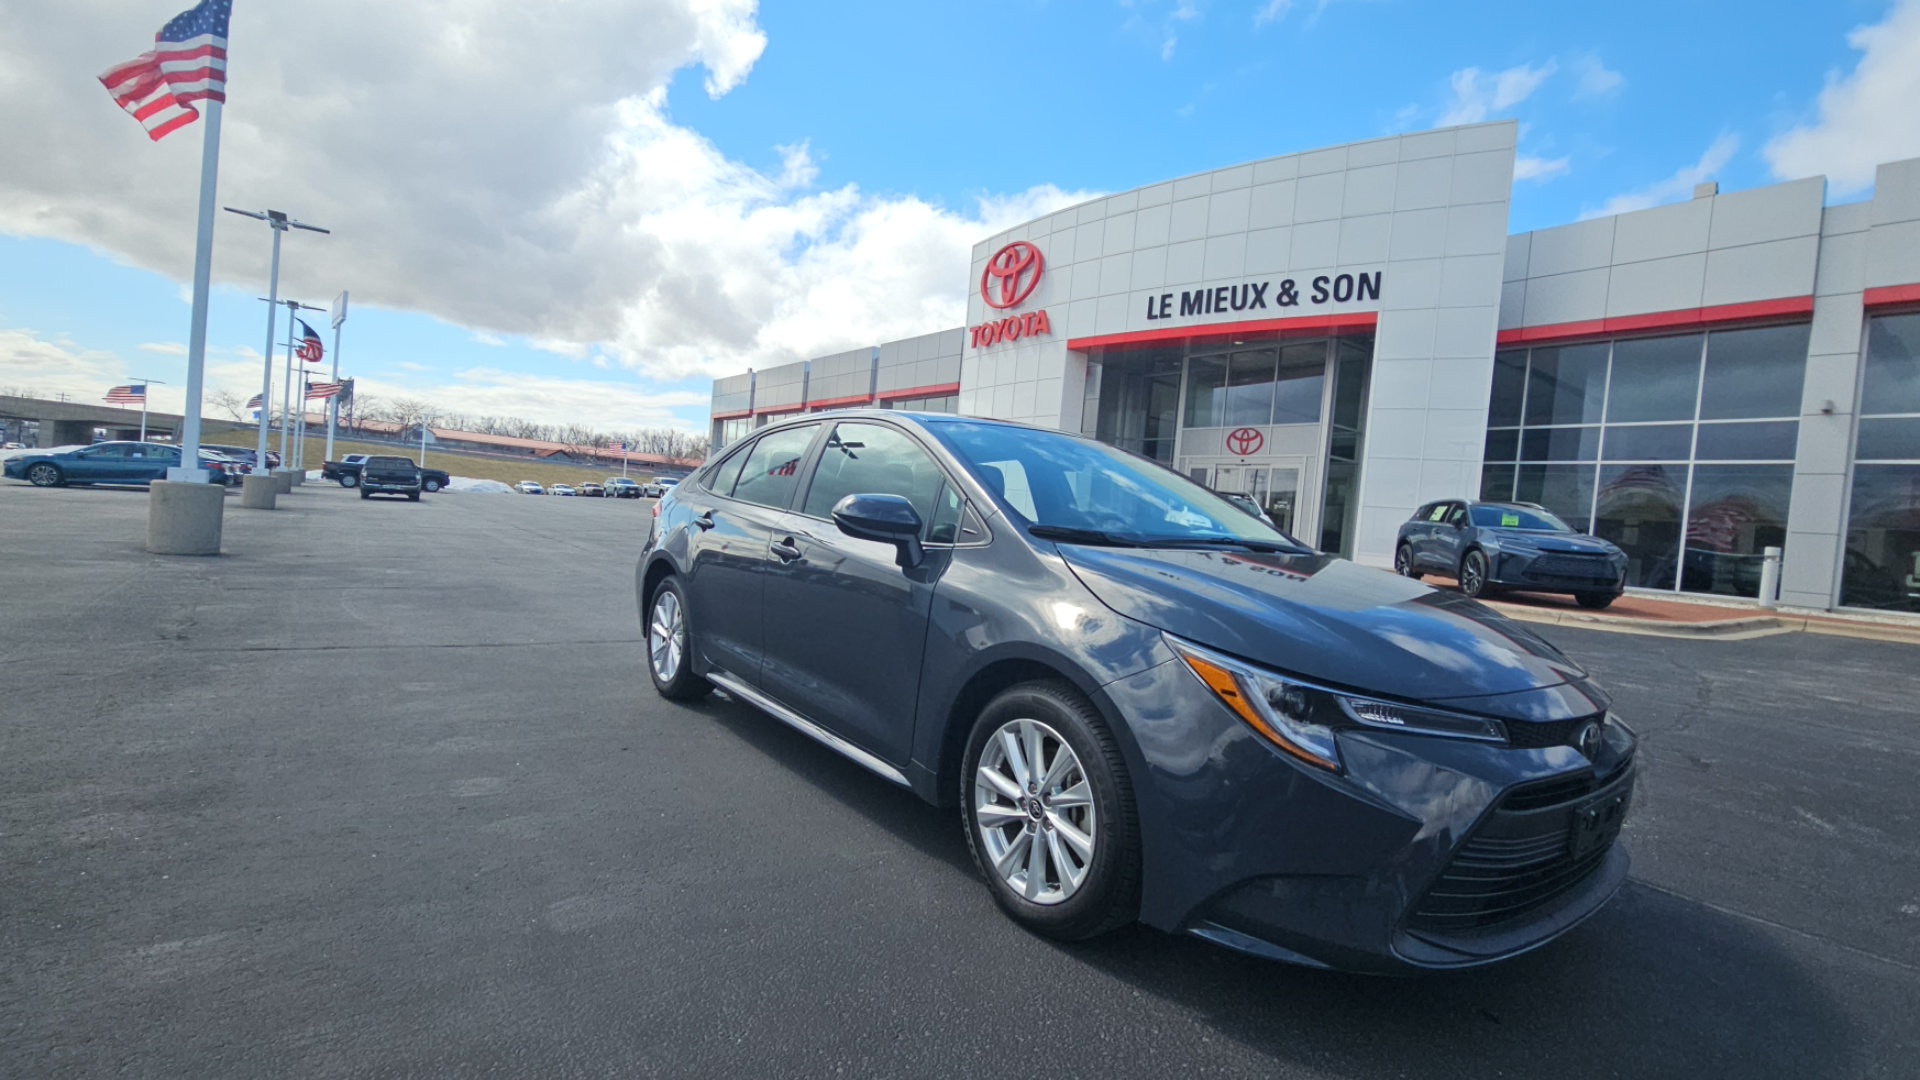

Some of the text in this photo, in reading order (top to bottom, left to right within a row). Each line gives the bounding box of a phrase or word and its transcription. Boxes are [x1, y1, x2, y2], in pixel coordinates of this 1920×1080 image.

[1146, 271, 1382, 320] LE MIEUX & SON
[969, 309, 1051, 349] TOYOTA
